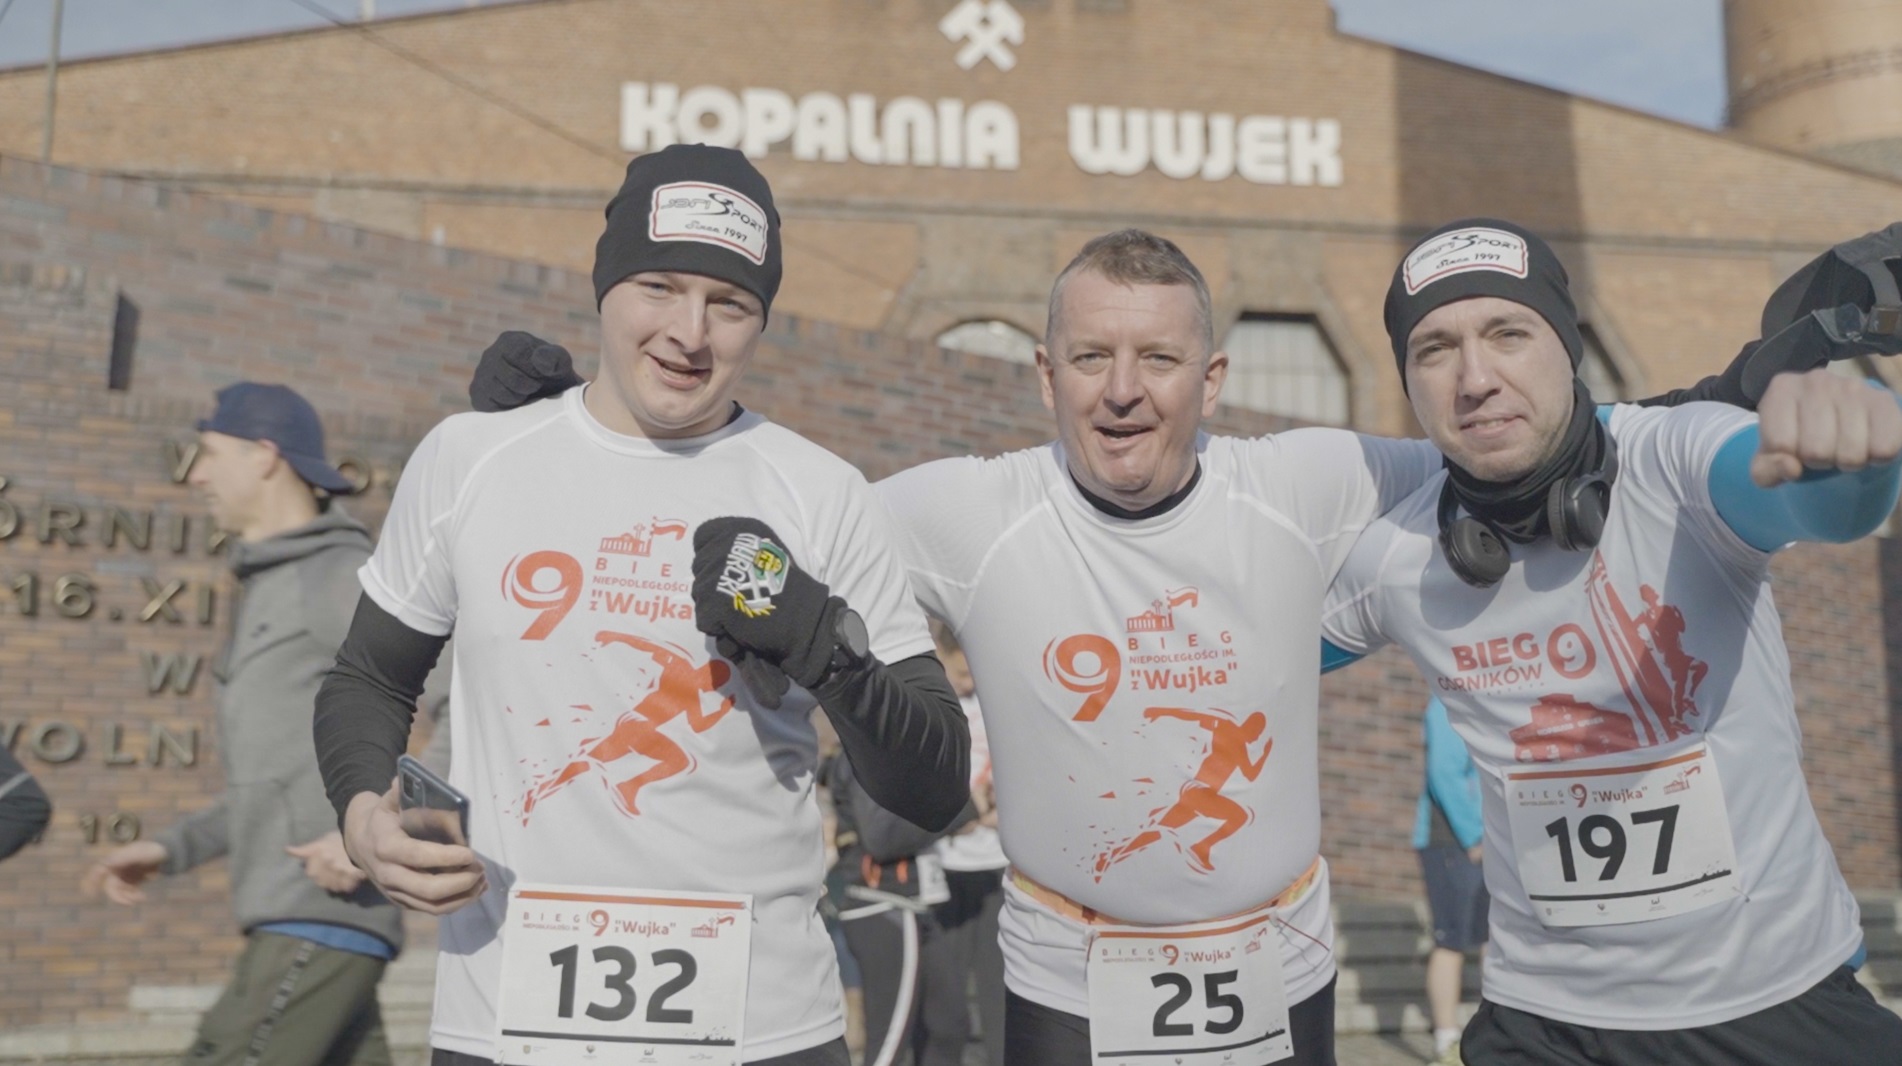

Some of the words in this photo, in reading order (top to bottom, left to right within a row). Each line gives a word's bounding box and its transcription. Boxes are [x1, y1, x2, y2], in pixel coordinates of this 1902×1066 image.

[621, 82, 1020, 170] KOPALNIA
[1068, 106, 1343, 187] WUJEK
[724, 227, 748, 242] 1997
[1474, 252, 1501, 262] 1997
[593, 576, 688, 592] NIEPODLEGŁOŚCI
[1043, 634, 1121, 721] 9
[1129, 650, 1218, 664] NIEPODLEGŁOŚCI
[1451, 632, 1540, 671] BIEG
[1545, 804, 1680, 882] 197
[549, 944, 697, 1024] 132
[1151, 969, 1244, 1037] 25
